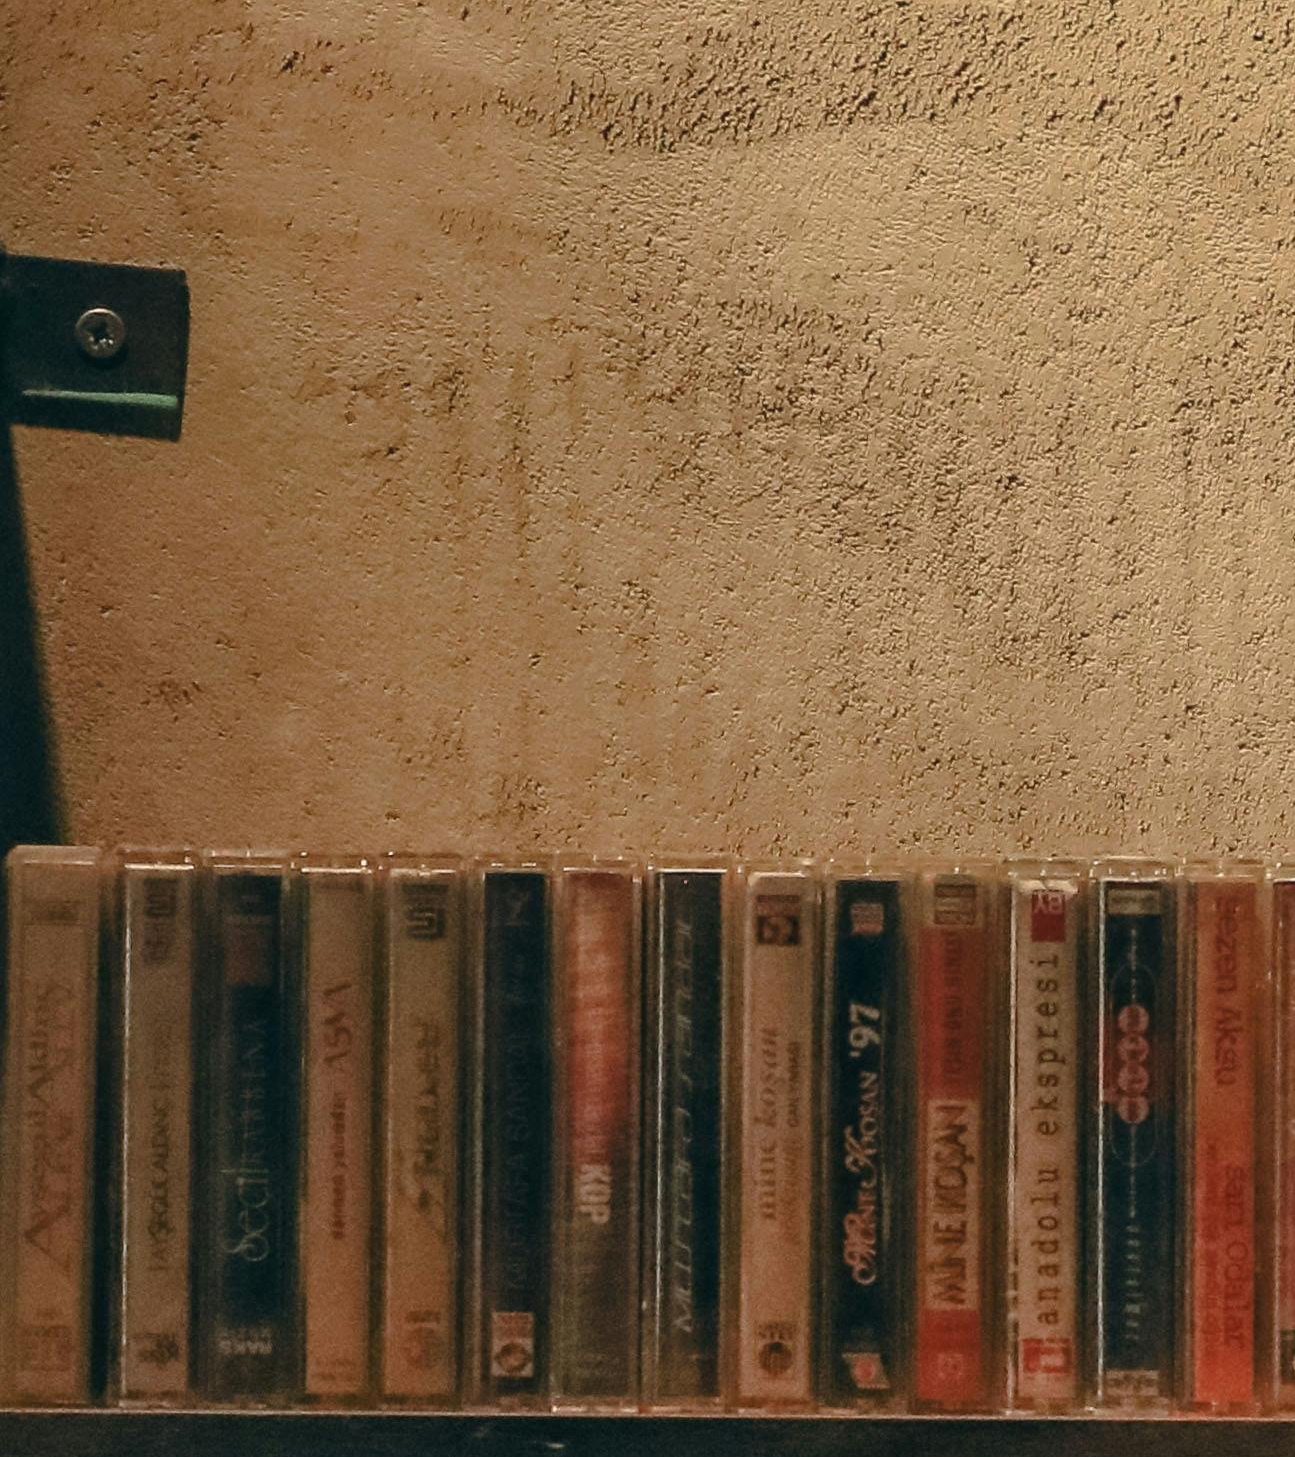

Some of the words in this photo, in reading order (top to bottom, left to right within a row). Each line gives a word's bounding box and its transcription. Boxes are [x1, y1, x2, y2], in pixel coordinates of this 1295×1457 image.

[849, 1001, 881, 1059] '97
[1031, 954, 1066, 1137] ekspresi
[935, 1104, 976, 1215] KOŞAN
[1031, 1167, 1061, 1325] anadolu
